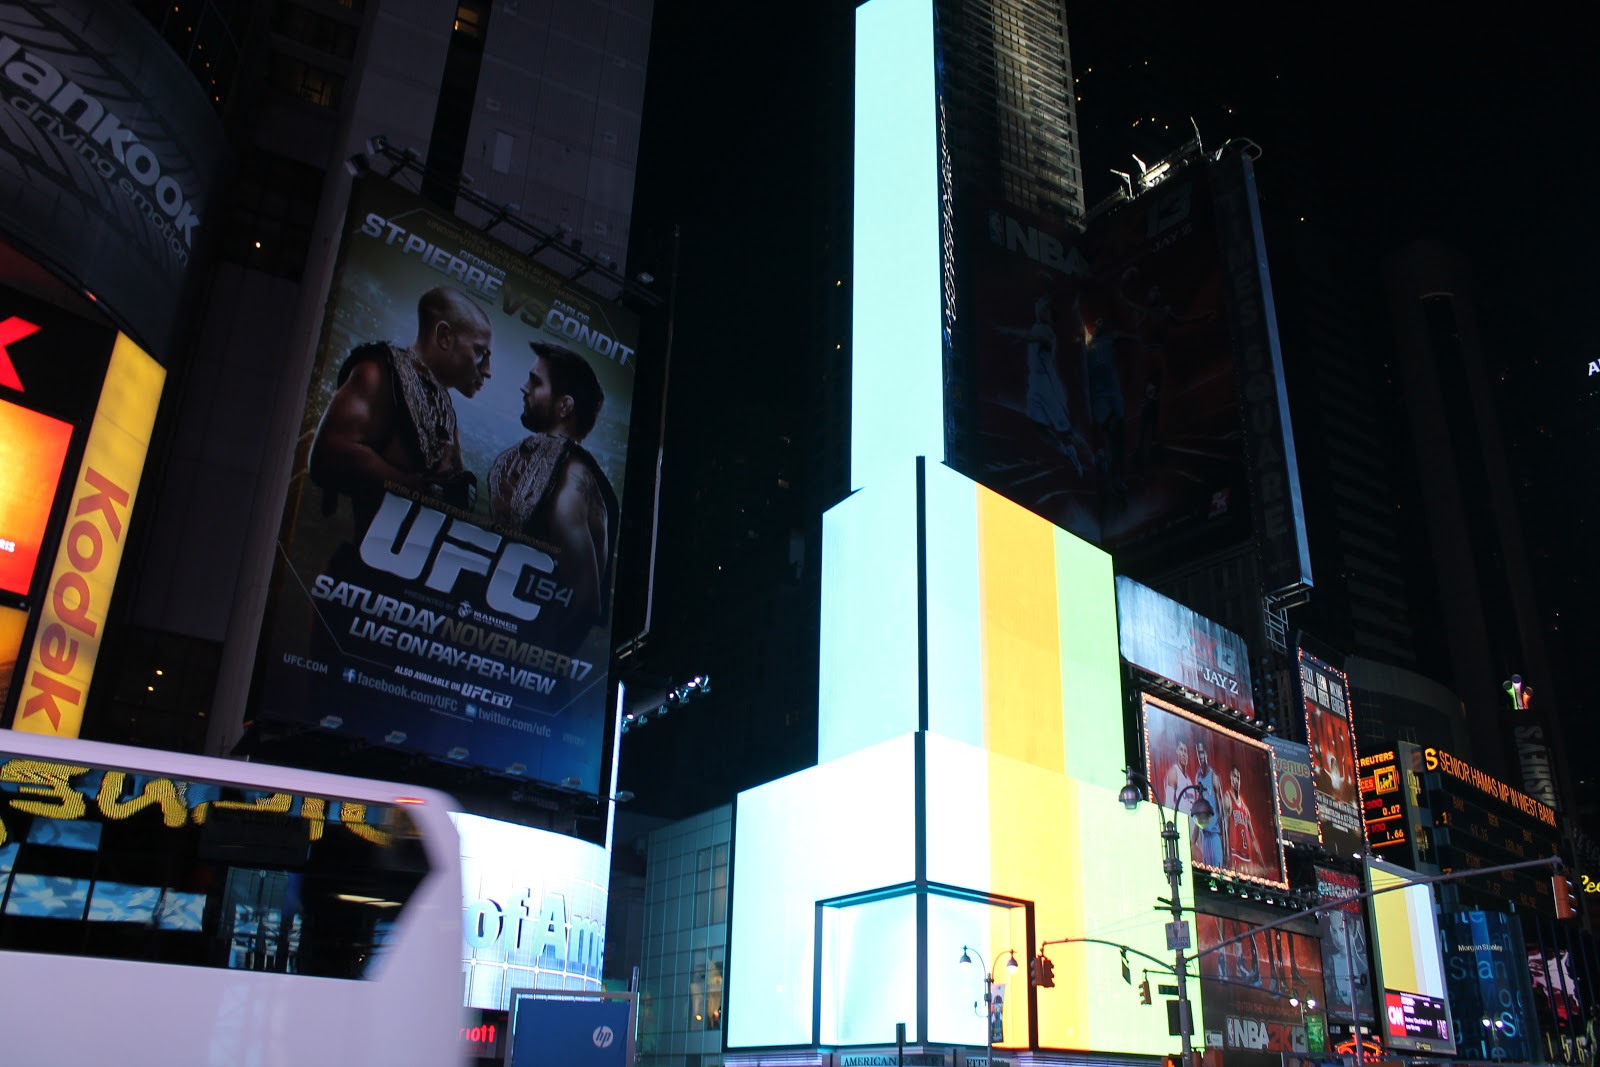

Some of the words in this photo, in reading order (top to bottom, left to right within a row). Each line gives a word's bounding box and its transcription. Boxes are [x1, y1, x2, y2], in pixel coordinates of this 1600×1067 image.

[11, 95, 117, 179] driving
[119, 177, 190, 268] emotion
[1005, 215, 1090, 276] NBA
[459, 249, 506, 280] GEORGES
[503, 281, 546, 329] VS
[553, 299, 590, 324] CARLOS
[545, 307, 635, 366] CONDIT
[360, 491, 556, 622] UFC
[22, 466, 130, 733] Kodak
[525, 573, 574, 608] 154
[311, 574, 446, 636] SATURDAY
[441, 617, 572, 678] NOVEMBER
[568, 659, 593, 682] 17
[473, 610, 518, 630] MARINES
[283, 652, 329, 675] UFC.COM
[350, 617, 395, 646] LIVE
[396, 632, 429, 656] ON
[427, 642, 557, 695] PAY-PER-VIEW
[357, 671, 459, 713] facebook.com/UFC
[394, 664, 413, 679] ALSO
[412, 669, 450, 689] AVAILABLE
[450, 681, 461, 691] ON
[1203, 666, 1228, 690] JAY
[478, 707, 552, 739] twitter.com/ufc
[1274, 758, 1311, 778] venue
[1360, 751, 1395, 767] REUTERS
[1279, 773, 1303, 816] Q
[1438, 750, 1472, 784] SENIOR
[1470, 766, 1499, 798] HAMAS
[1517, 791, 1539, 819] WEST
[1537, 802, 1557, 828] BANK
[1382, 804, 1400, 816] 0.07
[1386, 829, 1404, 840] 1.66
[463, 888, 531, 953] of
[531, 893, 605, 967] Am
[1387, 1005, 1405, 1026] CNN
[595, 1026, 612, 1048] hp
[1234, 1017, 1269, 1049] NBA
[844, 1056, 898, 1067] AMERICAN
